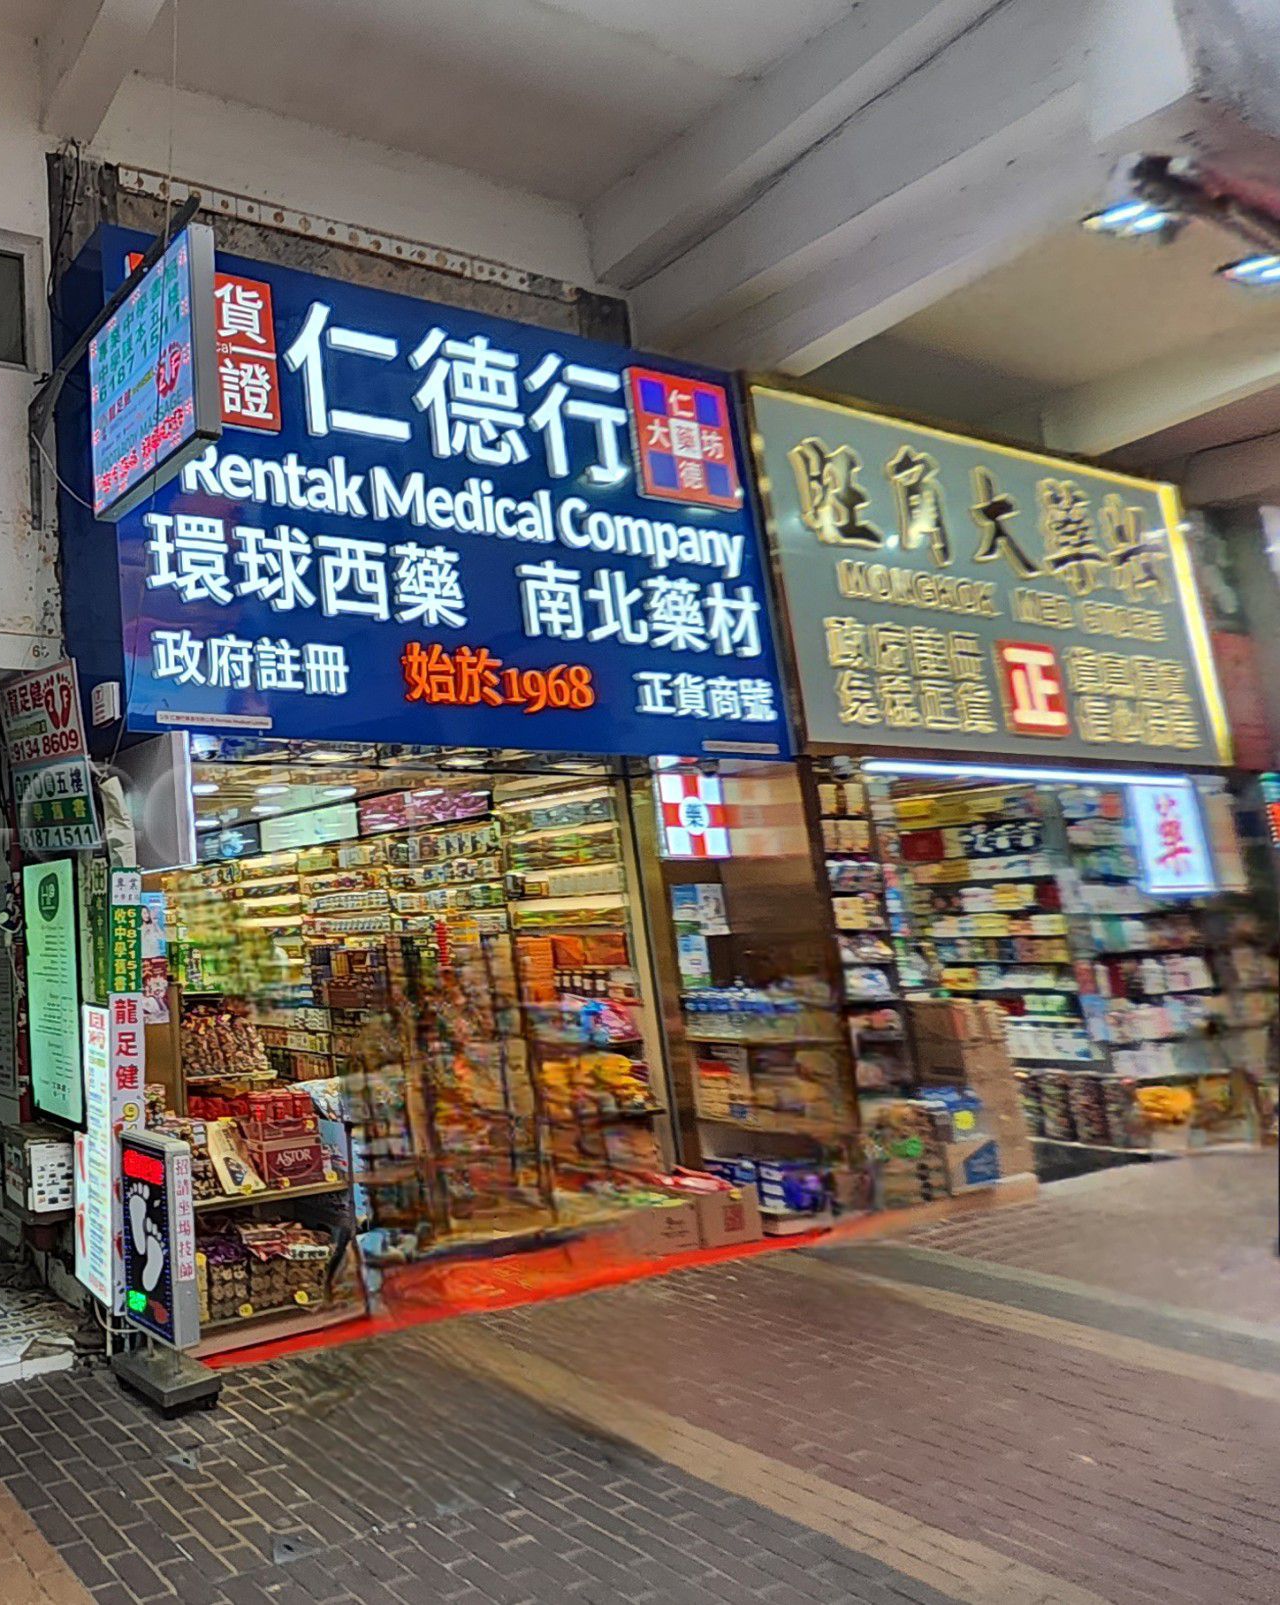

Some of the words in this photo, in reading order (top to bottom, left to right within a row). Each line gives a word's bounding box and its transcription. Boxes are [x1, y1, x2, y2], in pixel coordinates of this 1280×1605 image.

[282, 302, 628, 485] 仁德行
[181, 448, 365, 515] Rentak
[372, 472, 553, 543] Medical
[559, 497, 744, 578] Company
[145, 513, 468, 628] 環球西藥
[516, 562, 764, 658] 南北藥材
[150, 632, 350, 696] 政府註冊
[402, 642, 596, 713] 始於1968
[633, 671, 778, 723] 正貨商號
[42, 728, 80, 756] 8609
[114, 997, 139, 1092] 龍足健
[275, 1148, 314, 1167] ASTOR
